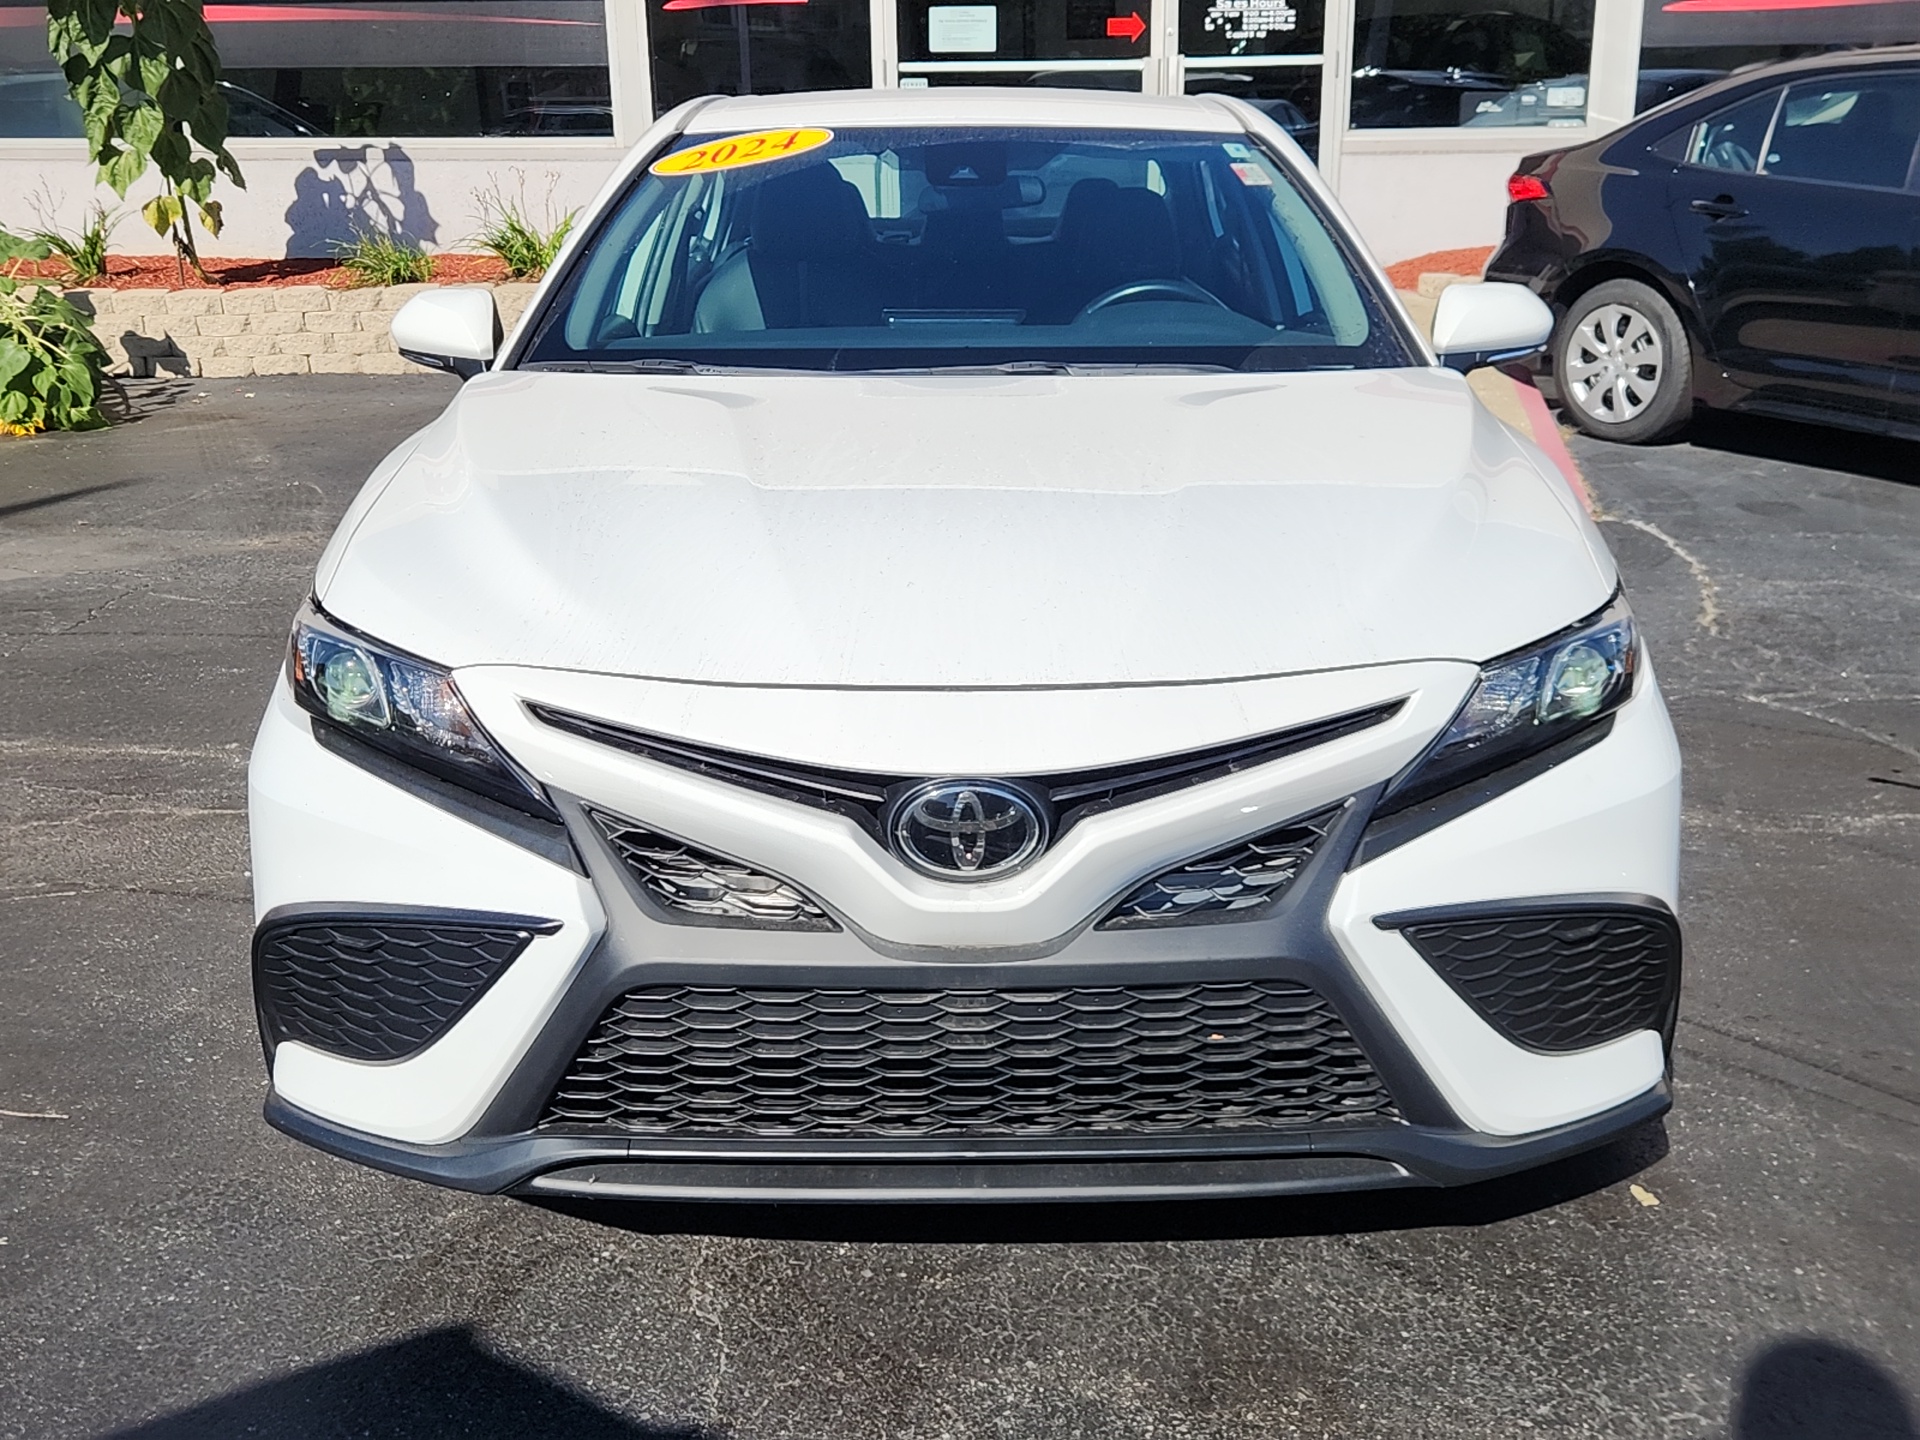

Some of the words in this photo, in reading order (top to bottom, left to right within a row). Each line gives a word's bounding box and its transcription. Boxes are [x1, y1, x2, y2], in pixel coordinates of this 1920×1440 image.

[1216, 0, 1248, 8] Saes
[1250, 0, 1286, 8] Hours
[680, 131, 800, 170] 2024
